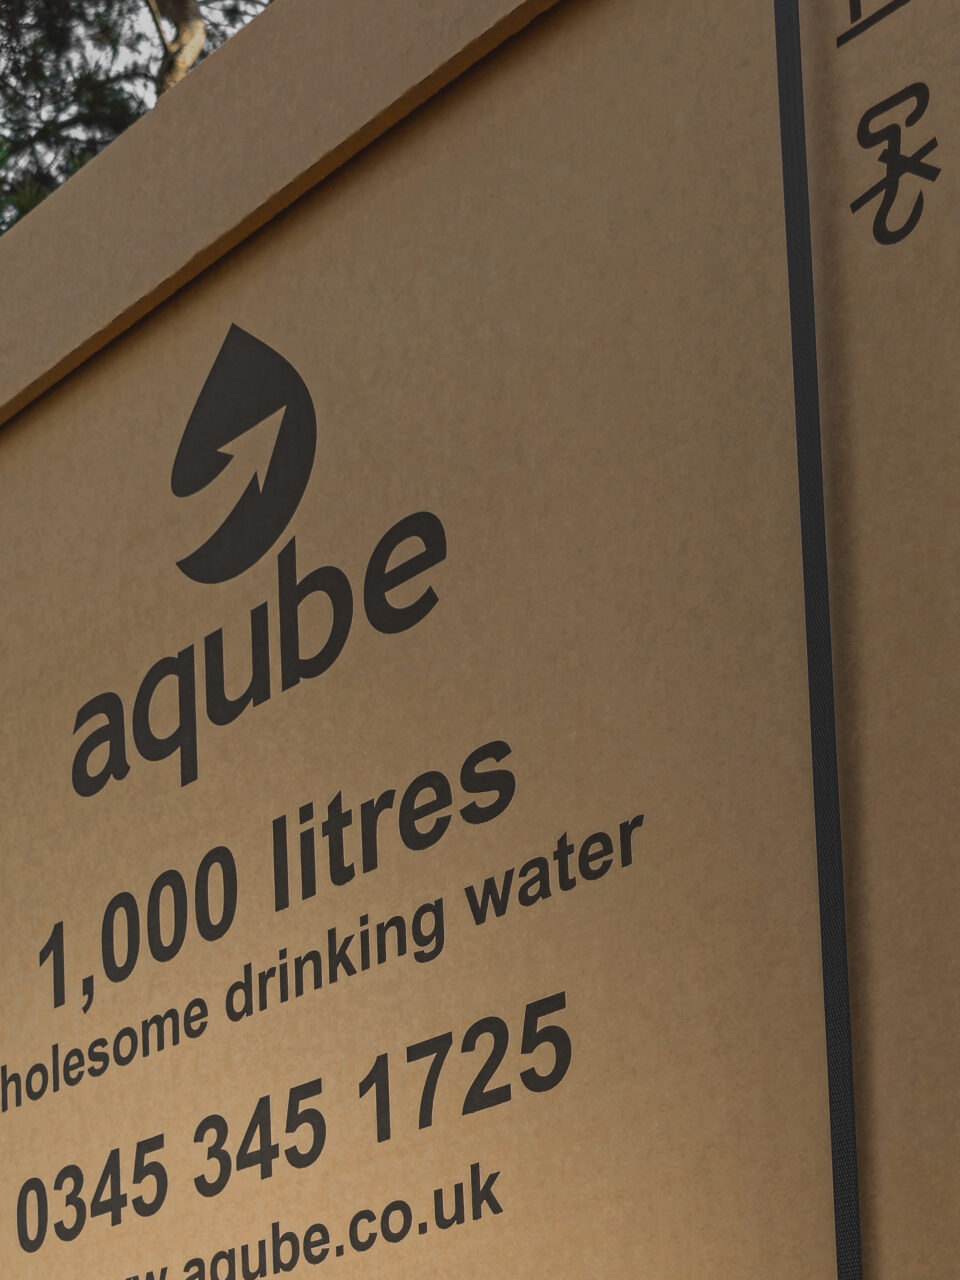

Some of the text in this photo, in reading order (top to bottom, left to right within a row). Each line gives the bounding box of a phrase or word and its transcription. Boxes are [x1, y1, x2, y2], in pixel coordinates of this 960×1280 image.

[72, 511, 447, 797] aqube
[40, 740, 516, 1014] 1,000 litres
[226, 898, 444, 1021] drinking
[465, 814, 644, 925] water
[16, 991, 572, 1253] 0345 345 1725
